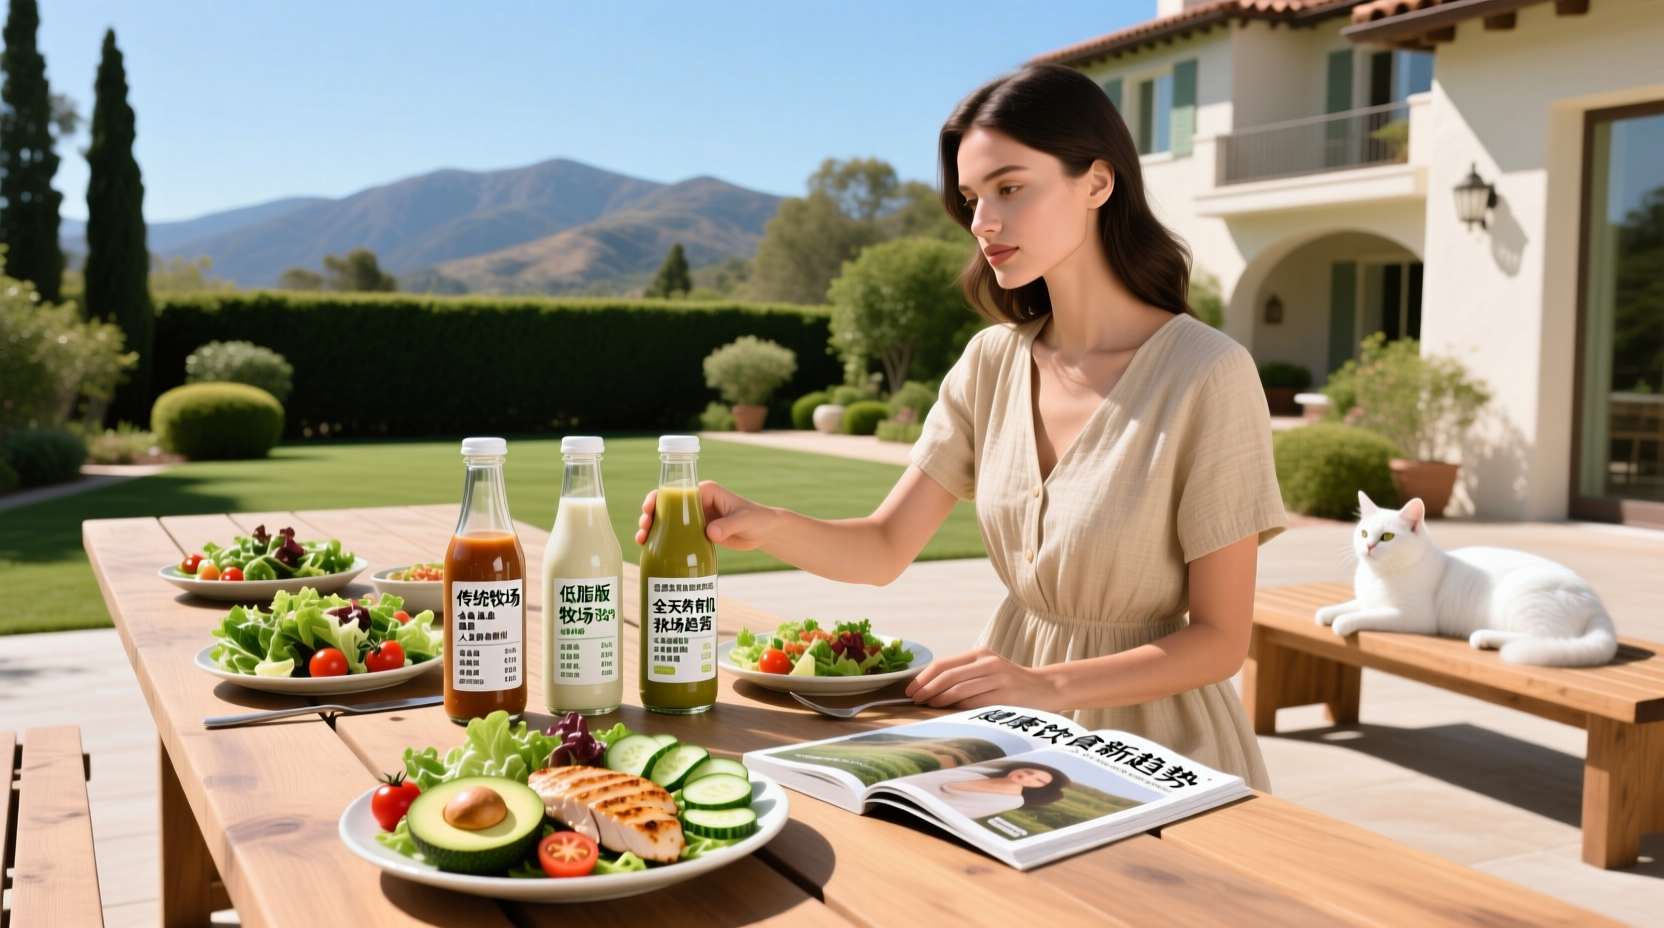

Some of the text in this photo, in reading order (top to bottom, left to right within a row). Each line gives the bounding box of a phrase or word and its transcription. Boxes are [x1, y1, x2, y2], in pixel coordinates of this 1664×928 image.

[457, 588, 520, 608] 传统牧场
[560, 584, 611, 604] 低脂版
